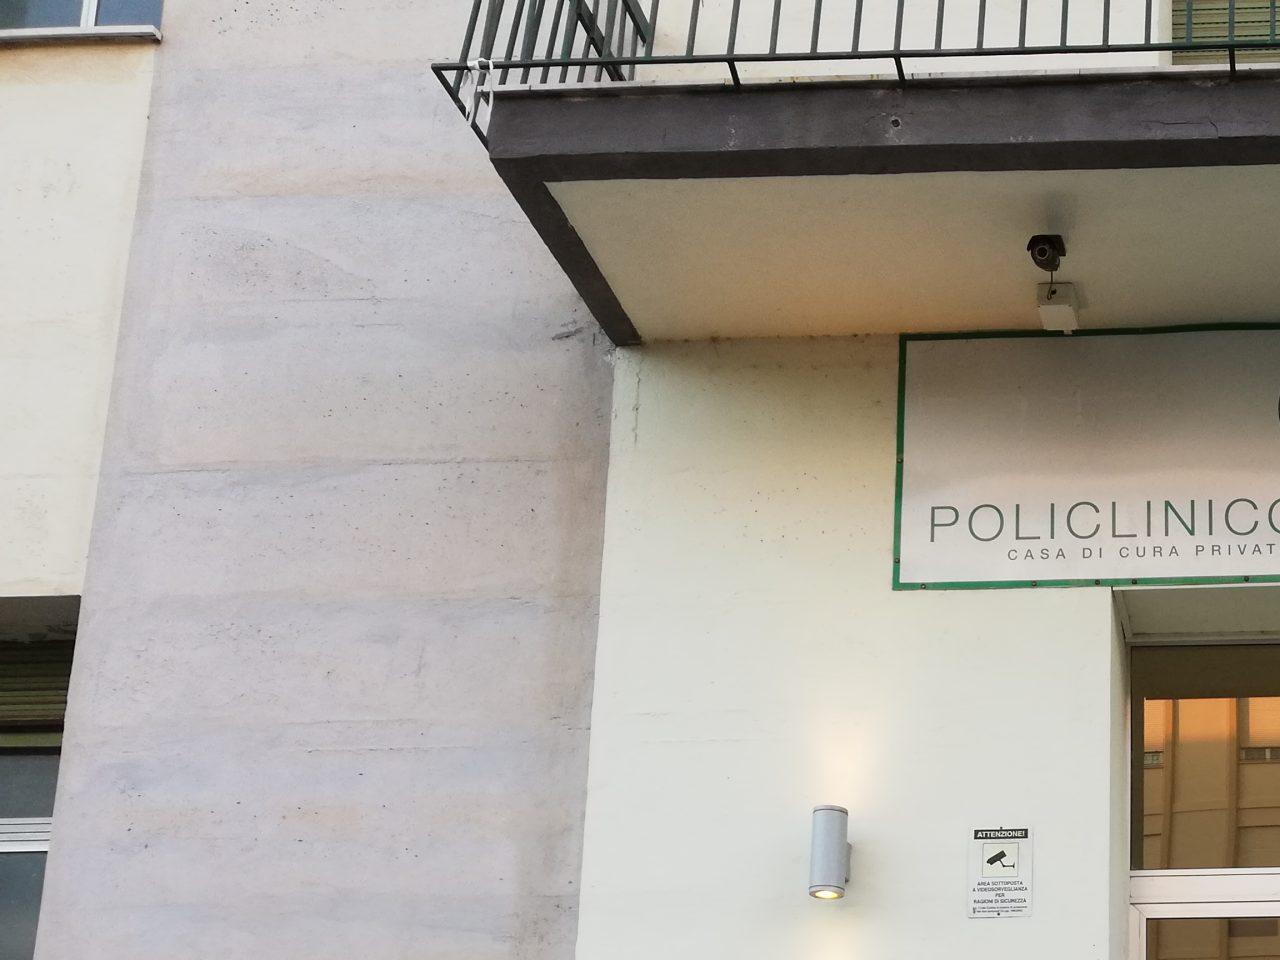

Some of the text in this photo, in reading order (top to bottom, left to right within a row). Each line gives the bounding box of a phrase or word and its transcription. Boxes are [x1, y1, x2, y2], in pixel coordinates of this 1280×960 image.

[1007, 547, 1066, 561] CASA
[1083, 547, 1103, 559] DI
[1119, 545, 1179, 558] CURA
